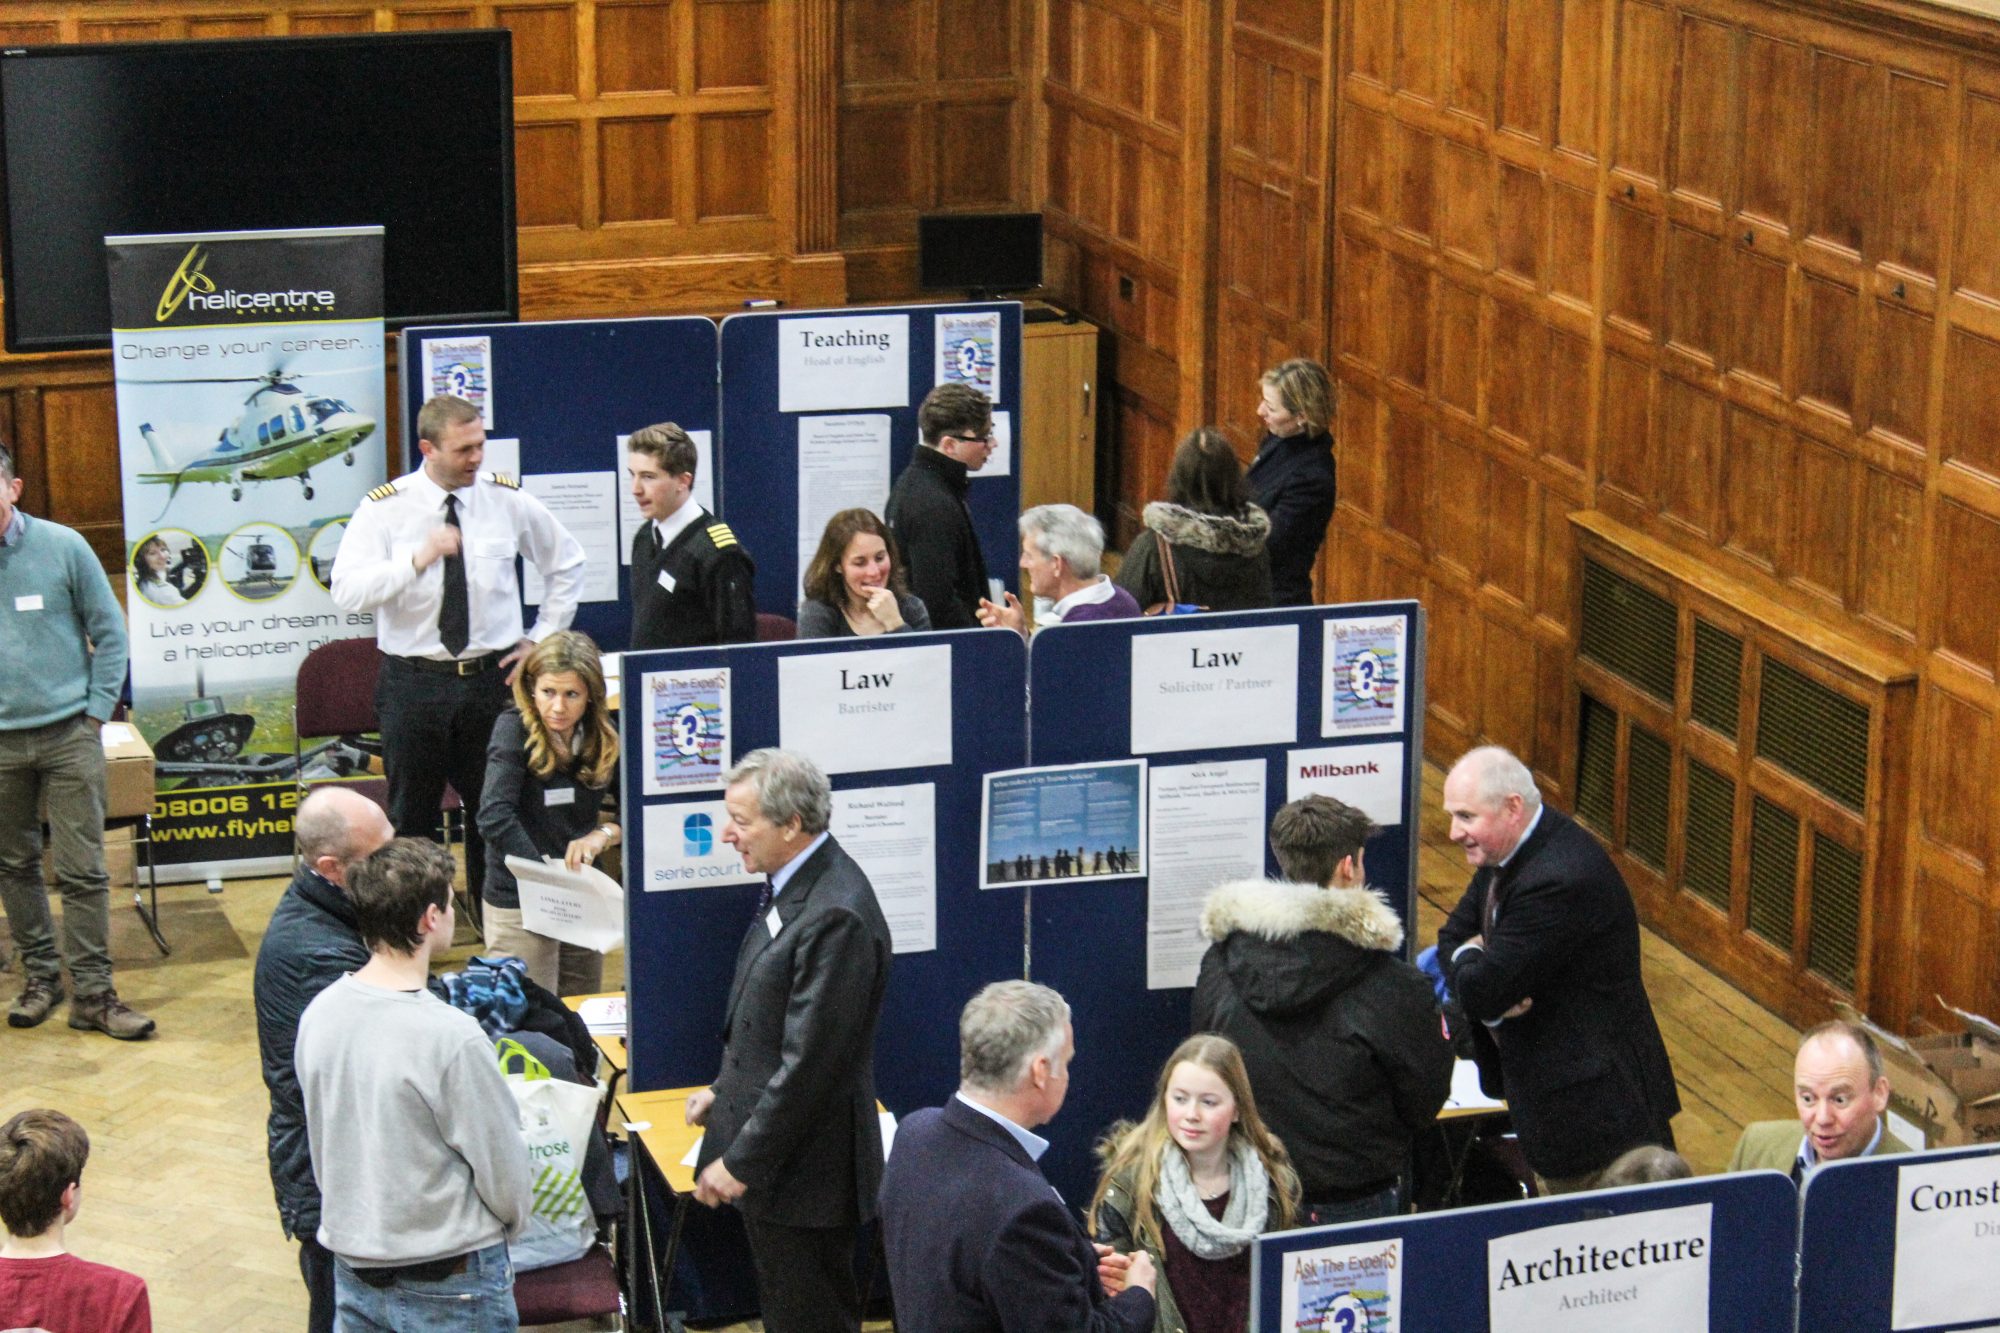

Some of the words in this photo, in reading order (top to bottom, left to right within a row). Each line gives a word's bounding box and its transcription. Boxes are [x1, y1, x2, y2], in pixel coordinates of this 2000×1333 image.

[188, 289, 336, 311] helicentre
[120, 342, 211, 360] Change
[219, 340, 272, 358] your
[800, 329, 891, 351] Teaching
[803, 355, 831, 367] Head
[833, 355, 844, 366] of
[847, 354, 886, 367] English
[150, 622, 194, 638] Live
[201, 619, 255, 637] your
[261, 614, 338, 631] dream
[346, 612, 374, 626] as
[163, 649, 178, 662] a
[185, 640, 299, 660] helicopter
[1191, 647, 1243, 669] Law
[840, 669, 895, 690] Law
[1159, 681, 1214, 695] Solicitor
[1226, 678, 1273, 691] Partner
[838, 701, 896, 715] Barrister
[1300, 761, 1380, 779] Milbank
[151, 795, 249, 819] 08006
[261, 791, 309, 810] 12
[698, 861, 741, 878] court
[1910, 1180, 2000, 1212] Const
[1294, 1256, 1318, 1282] Ask
[1321, 1258, 1344, 1274] The
[1497, 1237, 1705, 1291] Architecture
[1558, 1285, 1638, 1311] Architect
